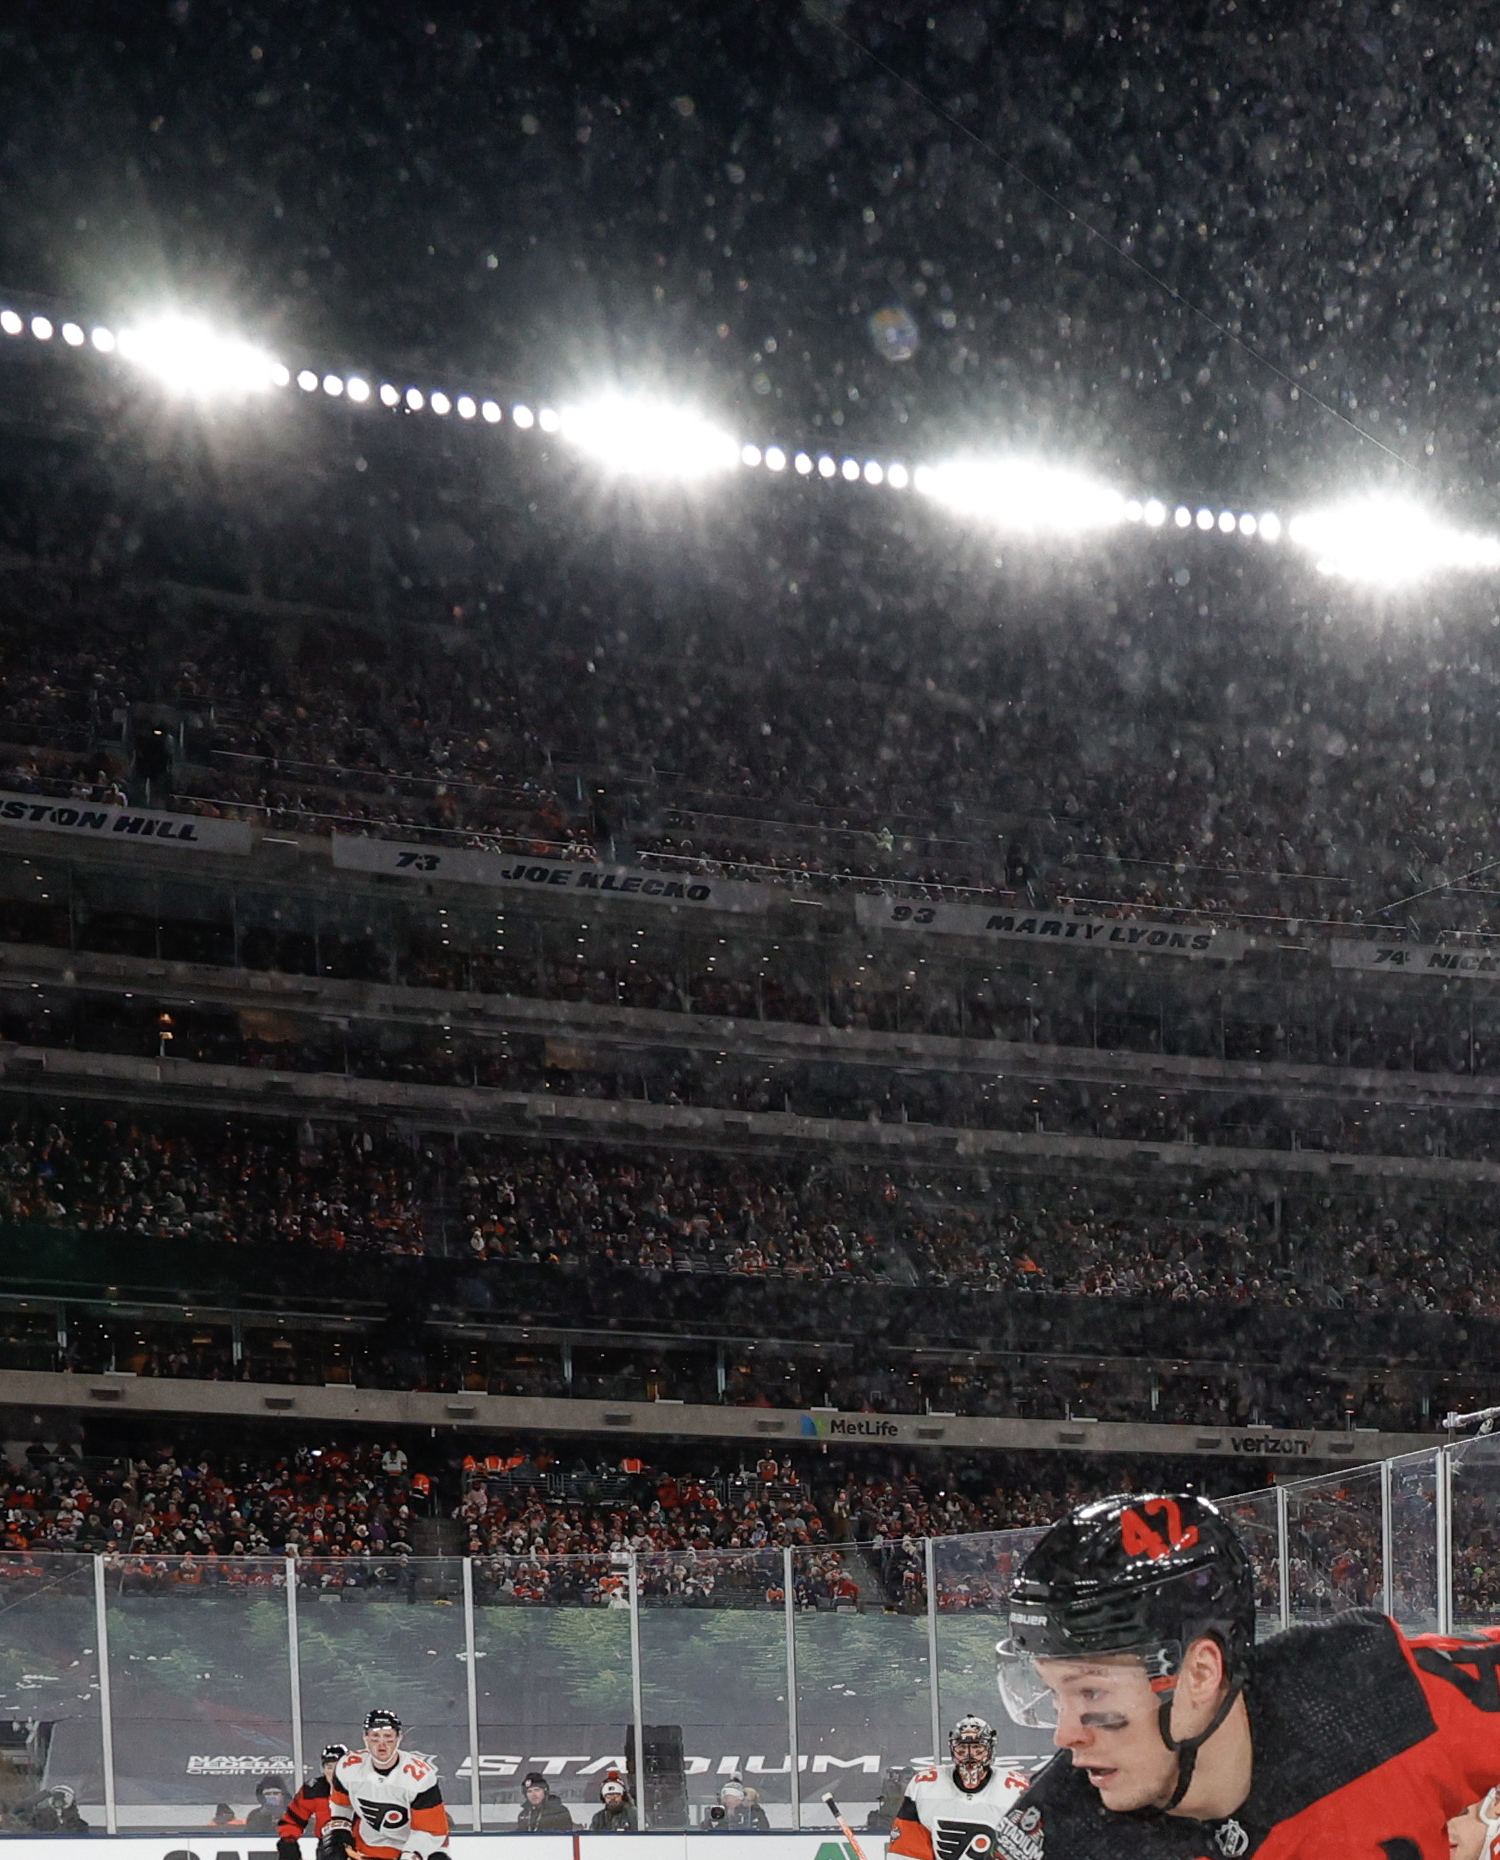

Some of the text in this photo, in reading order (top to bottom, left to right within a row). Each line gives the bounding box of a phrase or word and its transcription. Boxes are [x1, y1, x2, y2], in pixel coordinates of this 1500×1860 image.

[113, 816, 199, 843] HILL
[395, 851, 712, 901] 73 JOE KLECKO
[891, 905, 1212, 950] 93 MARTY LYONS
[1427, 953, 1500, 972] NICK
[1118, 1497, 1200, 1561] 42
[187, 1760, 297, 1771] FEDERAL
[189, 1755, 266, 1764] NAVY
[455, 1755, 881, 1777] STADIUM
[185, 1767, 249, 1776] Credit
